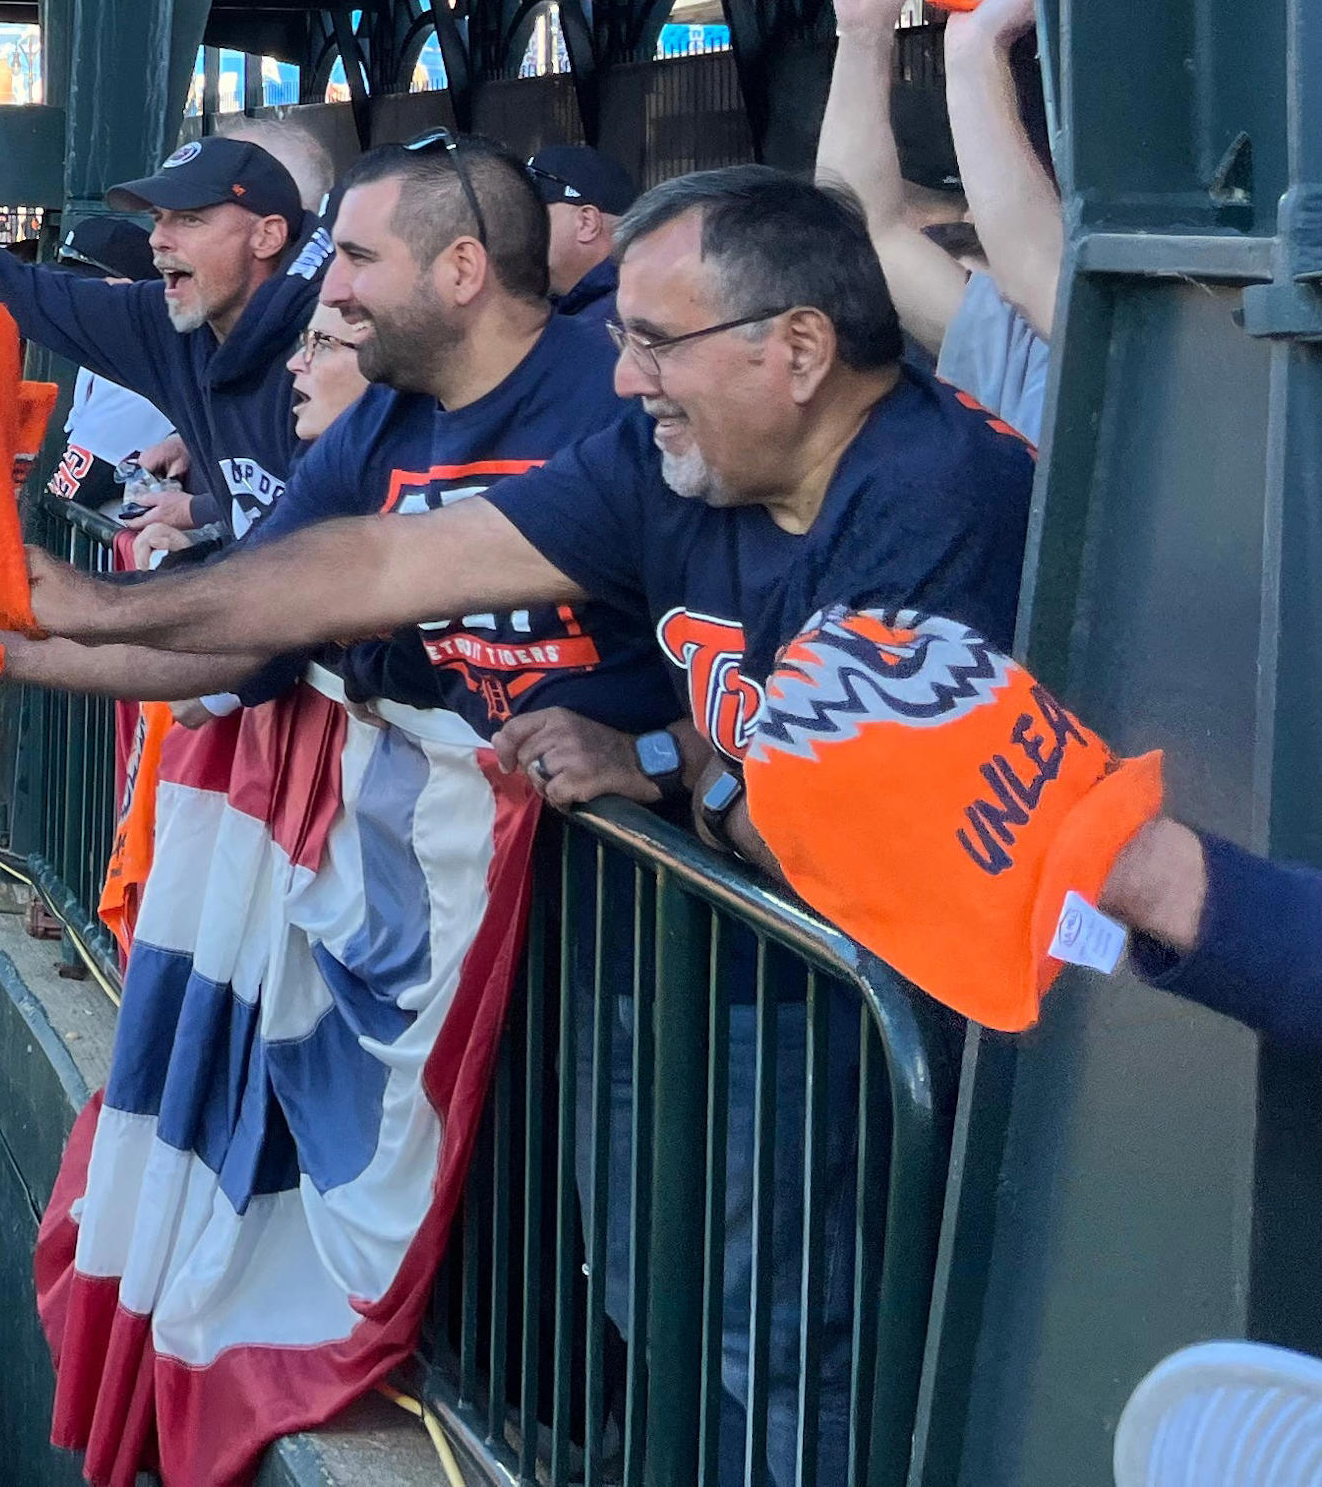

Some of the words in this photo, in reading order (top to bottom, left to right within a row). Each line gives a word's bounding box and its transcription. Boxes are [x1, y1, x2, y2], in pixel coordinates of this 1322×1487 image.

[426, 638, 481, 661] ETROIT
[485, 645, 560, 667] TIGERS
[956, 684, 1089, 876] UNLEA
